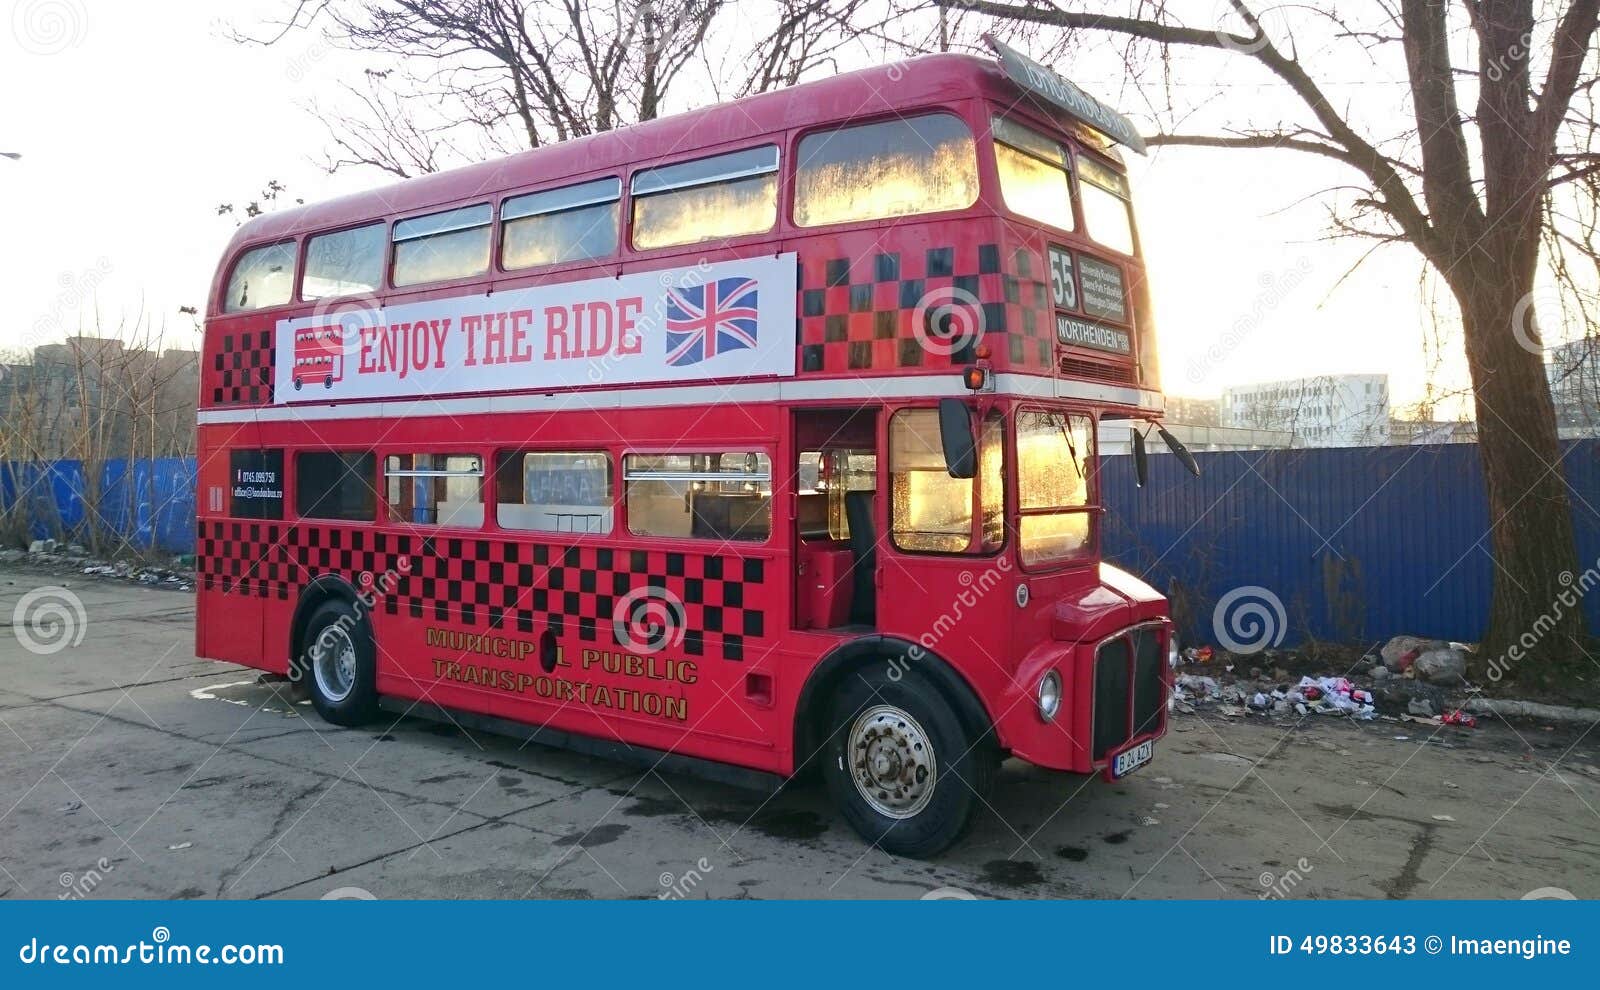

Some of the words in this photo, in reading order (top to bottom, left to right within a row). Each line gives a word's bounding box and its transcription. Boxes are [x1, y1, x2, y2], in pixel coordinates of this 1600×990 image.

[1049, 251, 1075, 307] 55
[357, 318, 452, 381] ENJOY
[461, 310, 533, 368] THE
[543, 296, 643, 361] RIDE
[1058, 319, 1118, 349] NORTHENDEN
[582, 648, 698, 684] PUBLIC
[432, 659, 688, 721] TRANSPORTATION
[1119, 756, 1125, 771] B
